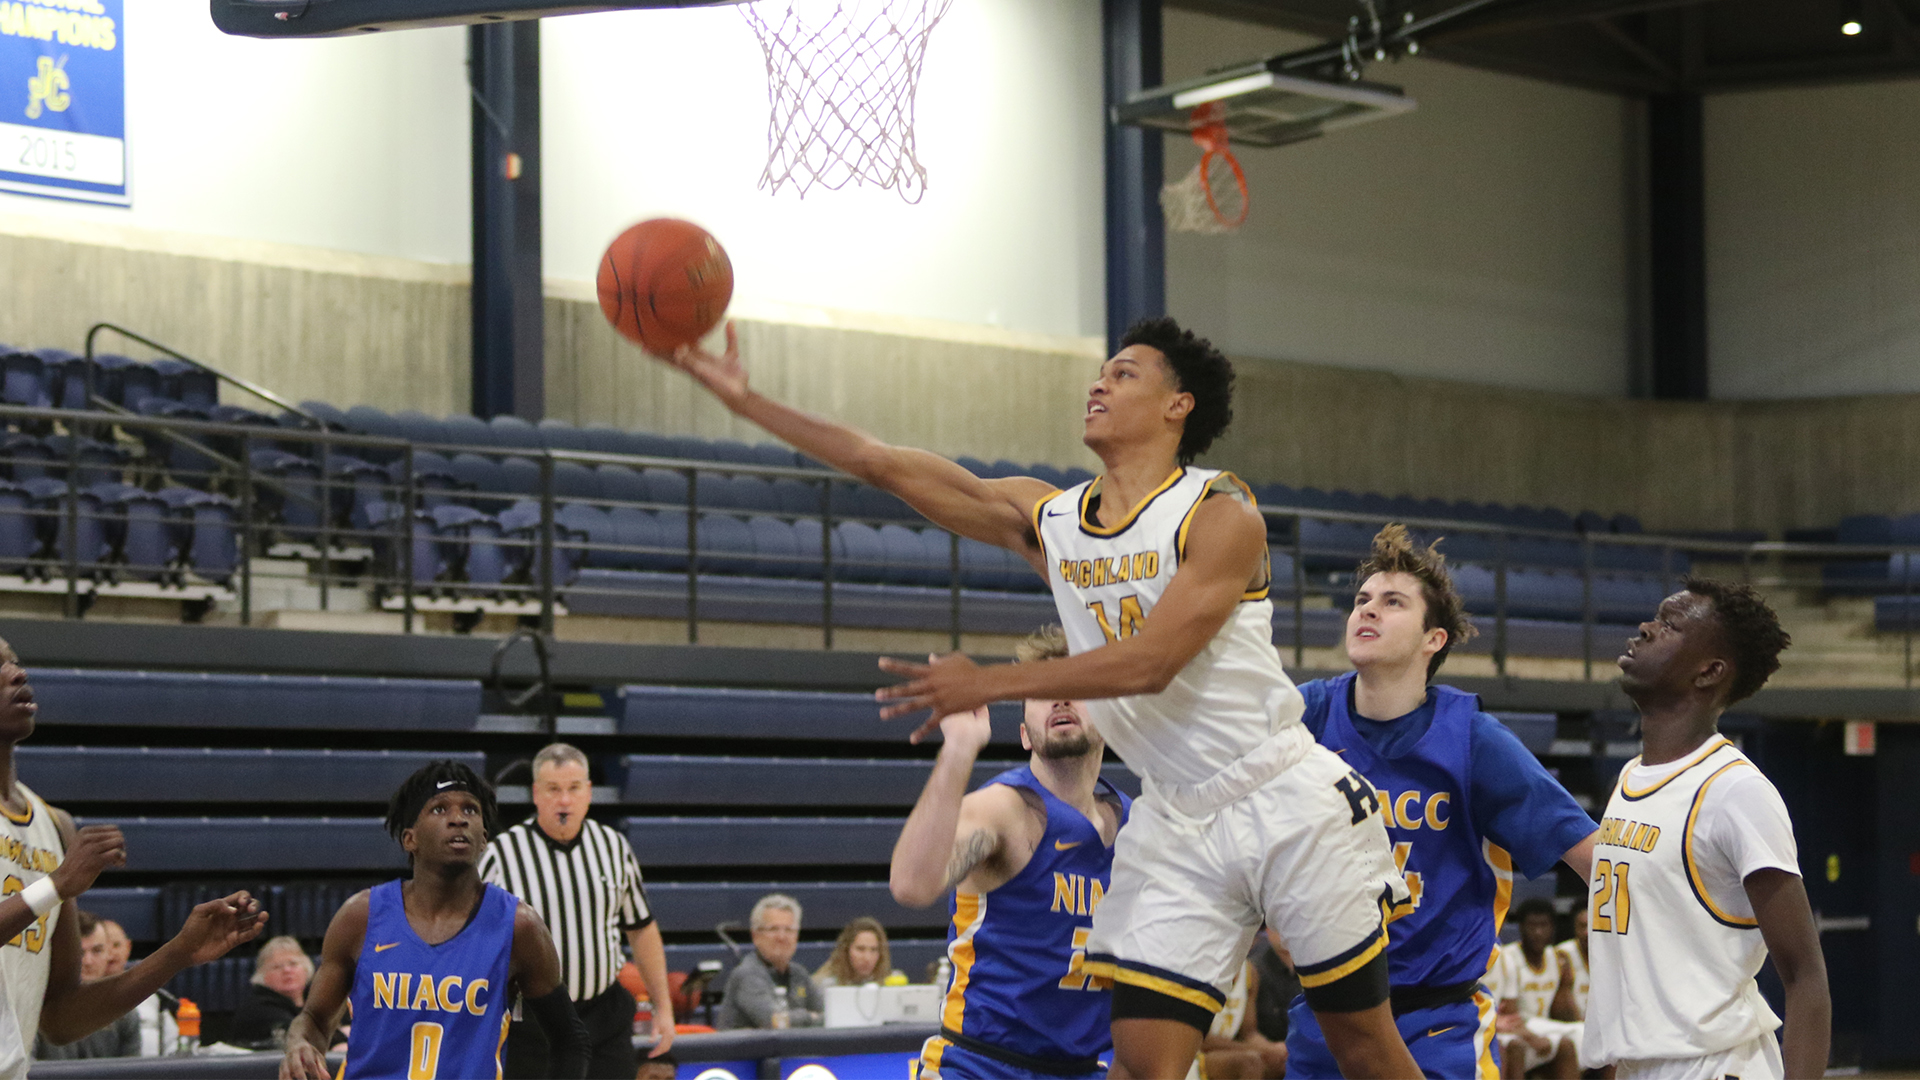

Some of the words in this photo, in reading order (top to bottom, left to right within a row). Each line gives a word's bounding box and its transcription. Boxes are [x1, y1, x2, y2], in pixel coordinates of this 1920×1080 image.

[19, 135, 77, 171] 2015
[1059, 550, 1159, 588] HIGHLAND
[1592, 858, 1630, 935] 21
[373, 972, 489, 1016] NIACC
[408, 1021, 444, 1080] 0
